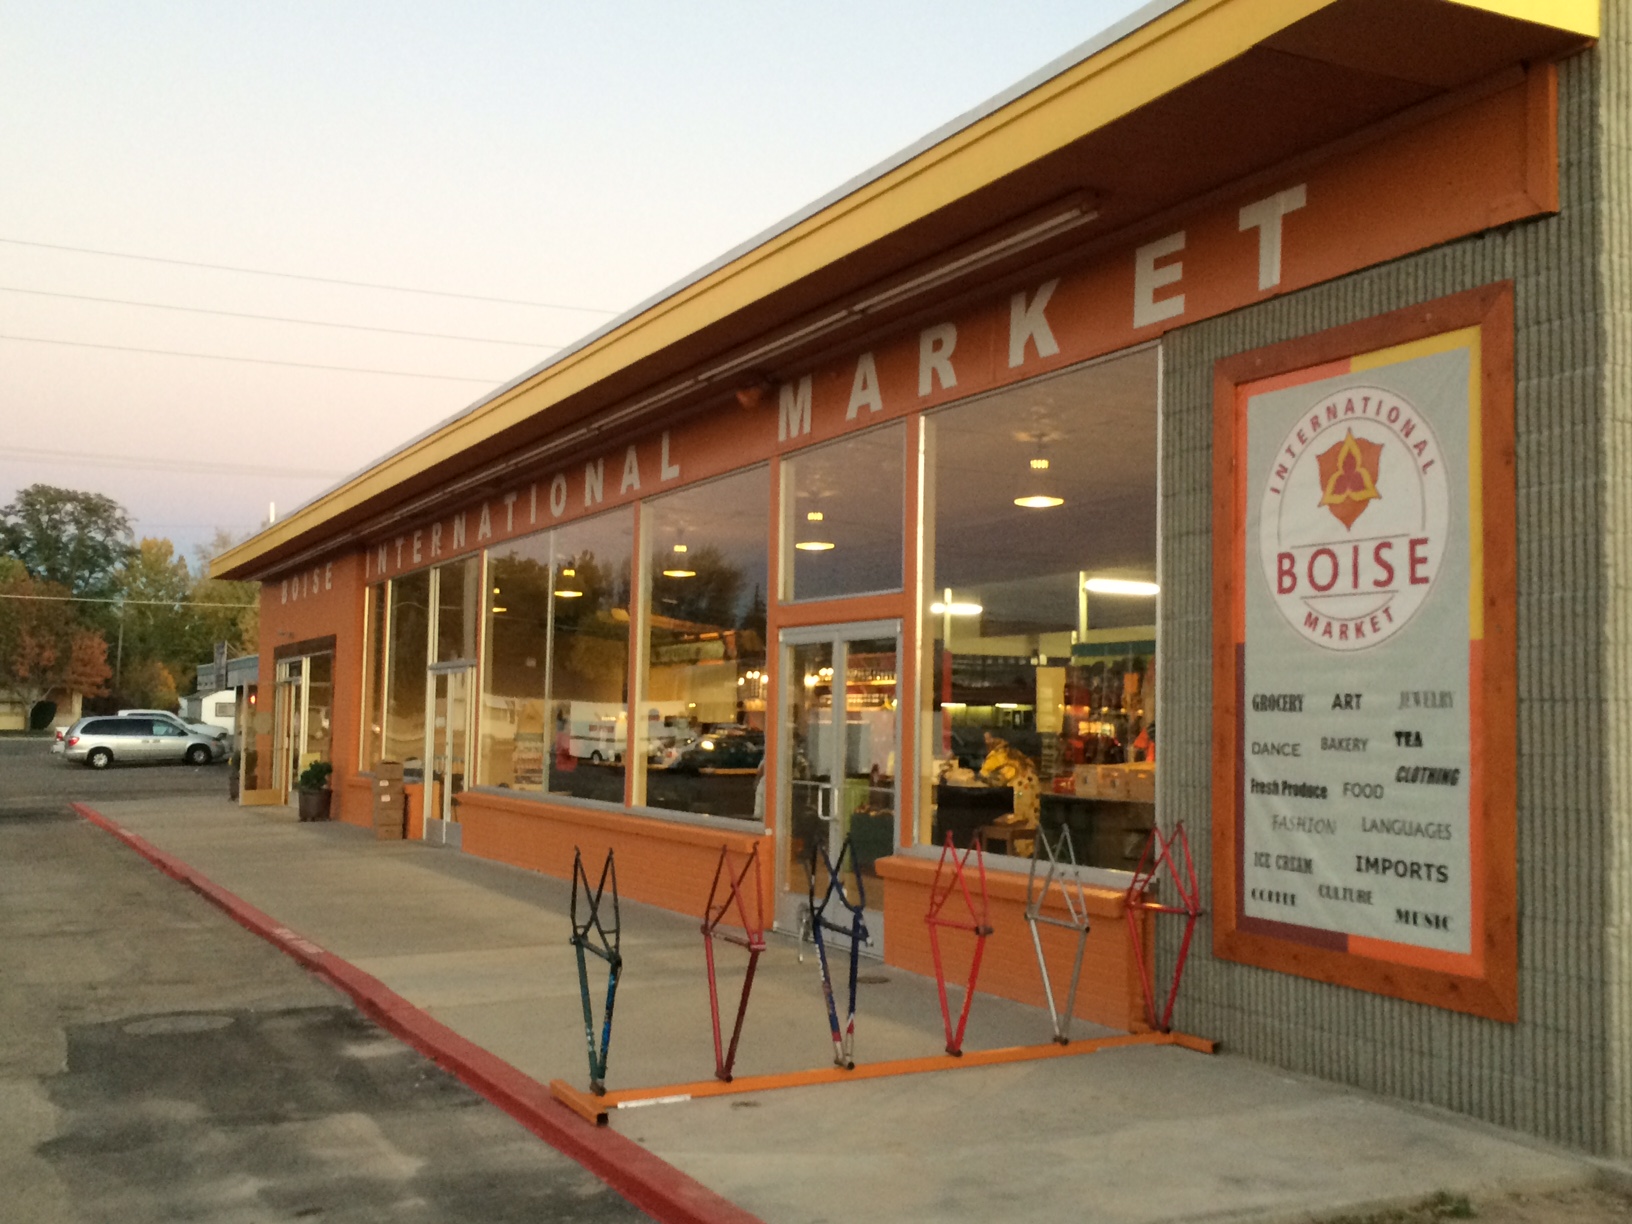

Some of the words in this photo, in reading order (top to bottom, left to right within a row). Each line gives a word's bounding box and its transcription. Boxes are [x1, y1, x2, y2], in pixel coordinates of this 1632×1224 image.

[281, 561, 333, 605] BOISE
[365, 431, 681, 579] INTERNATIONAL
[778, 183, 1307, 442] MARKET
[1269, 396, 1436, 495] INTERNATIONAL
[1277, 537, 1430, 595] BOISE
[1304, 605, 1395, 641] MARKET
[1252, 693, 1302, 712] GROCERY
[1331, 693, 1361, 710] ART
[1251, 741, 1300, 756] DANCE
[1320, 736, 1367, 751] BAKERY
[1394, 730, 1423, 747] TEA
[1395, 765, 1459, 786] CLOTHING
[1250, 777, 1280, 796] Fresh
[1281, 780, 1327, 799] Produce
[1342, 782, 1383, 799] FOOD
[1271, 814, 1335, 834] FASHION
[1361, 816, 1451, 840] LANGUAGES
[1253, 851, 1270, 868] ICE
[1275, 854, 1312, 874] CREAM
[1355, 855, 1449, 883] IMPORTS
[1317, 884, 1372, 905] CULTURE
